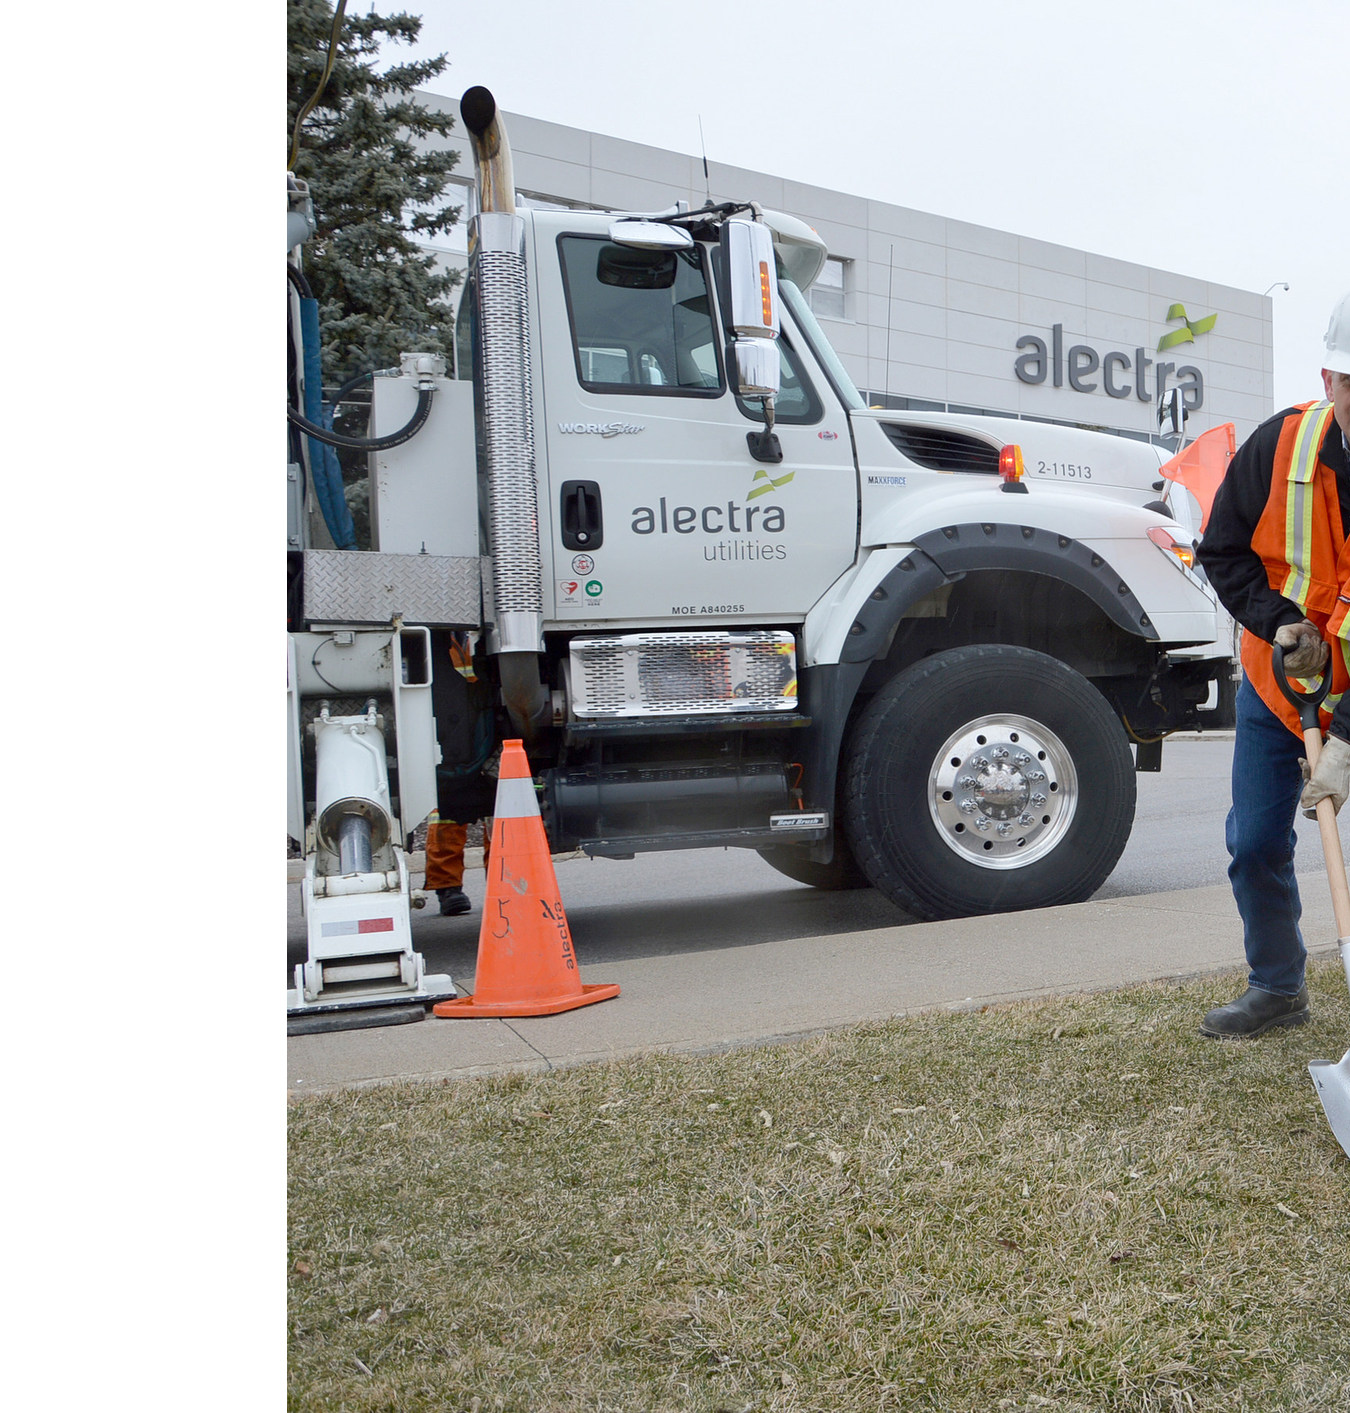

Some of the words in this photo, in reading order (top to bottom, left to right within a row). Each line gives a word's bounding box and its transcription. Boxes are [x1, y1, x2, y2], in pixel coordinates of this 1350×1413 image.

[1014, 323, 1204, 411] alectra
[1037, 460, 1092, 479] 2-11513
[867, 476, 907, 486] MAXXFORCE
[631, 496, 785, 534] alectra
[703, 540, 787, 561] utilities
[671, 606, 696, 615] MOE
[700, 604, 745, 614] A840255
[553, 901, 575, 970] alectra
